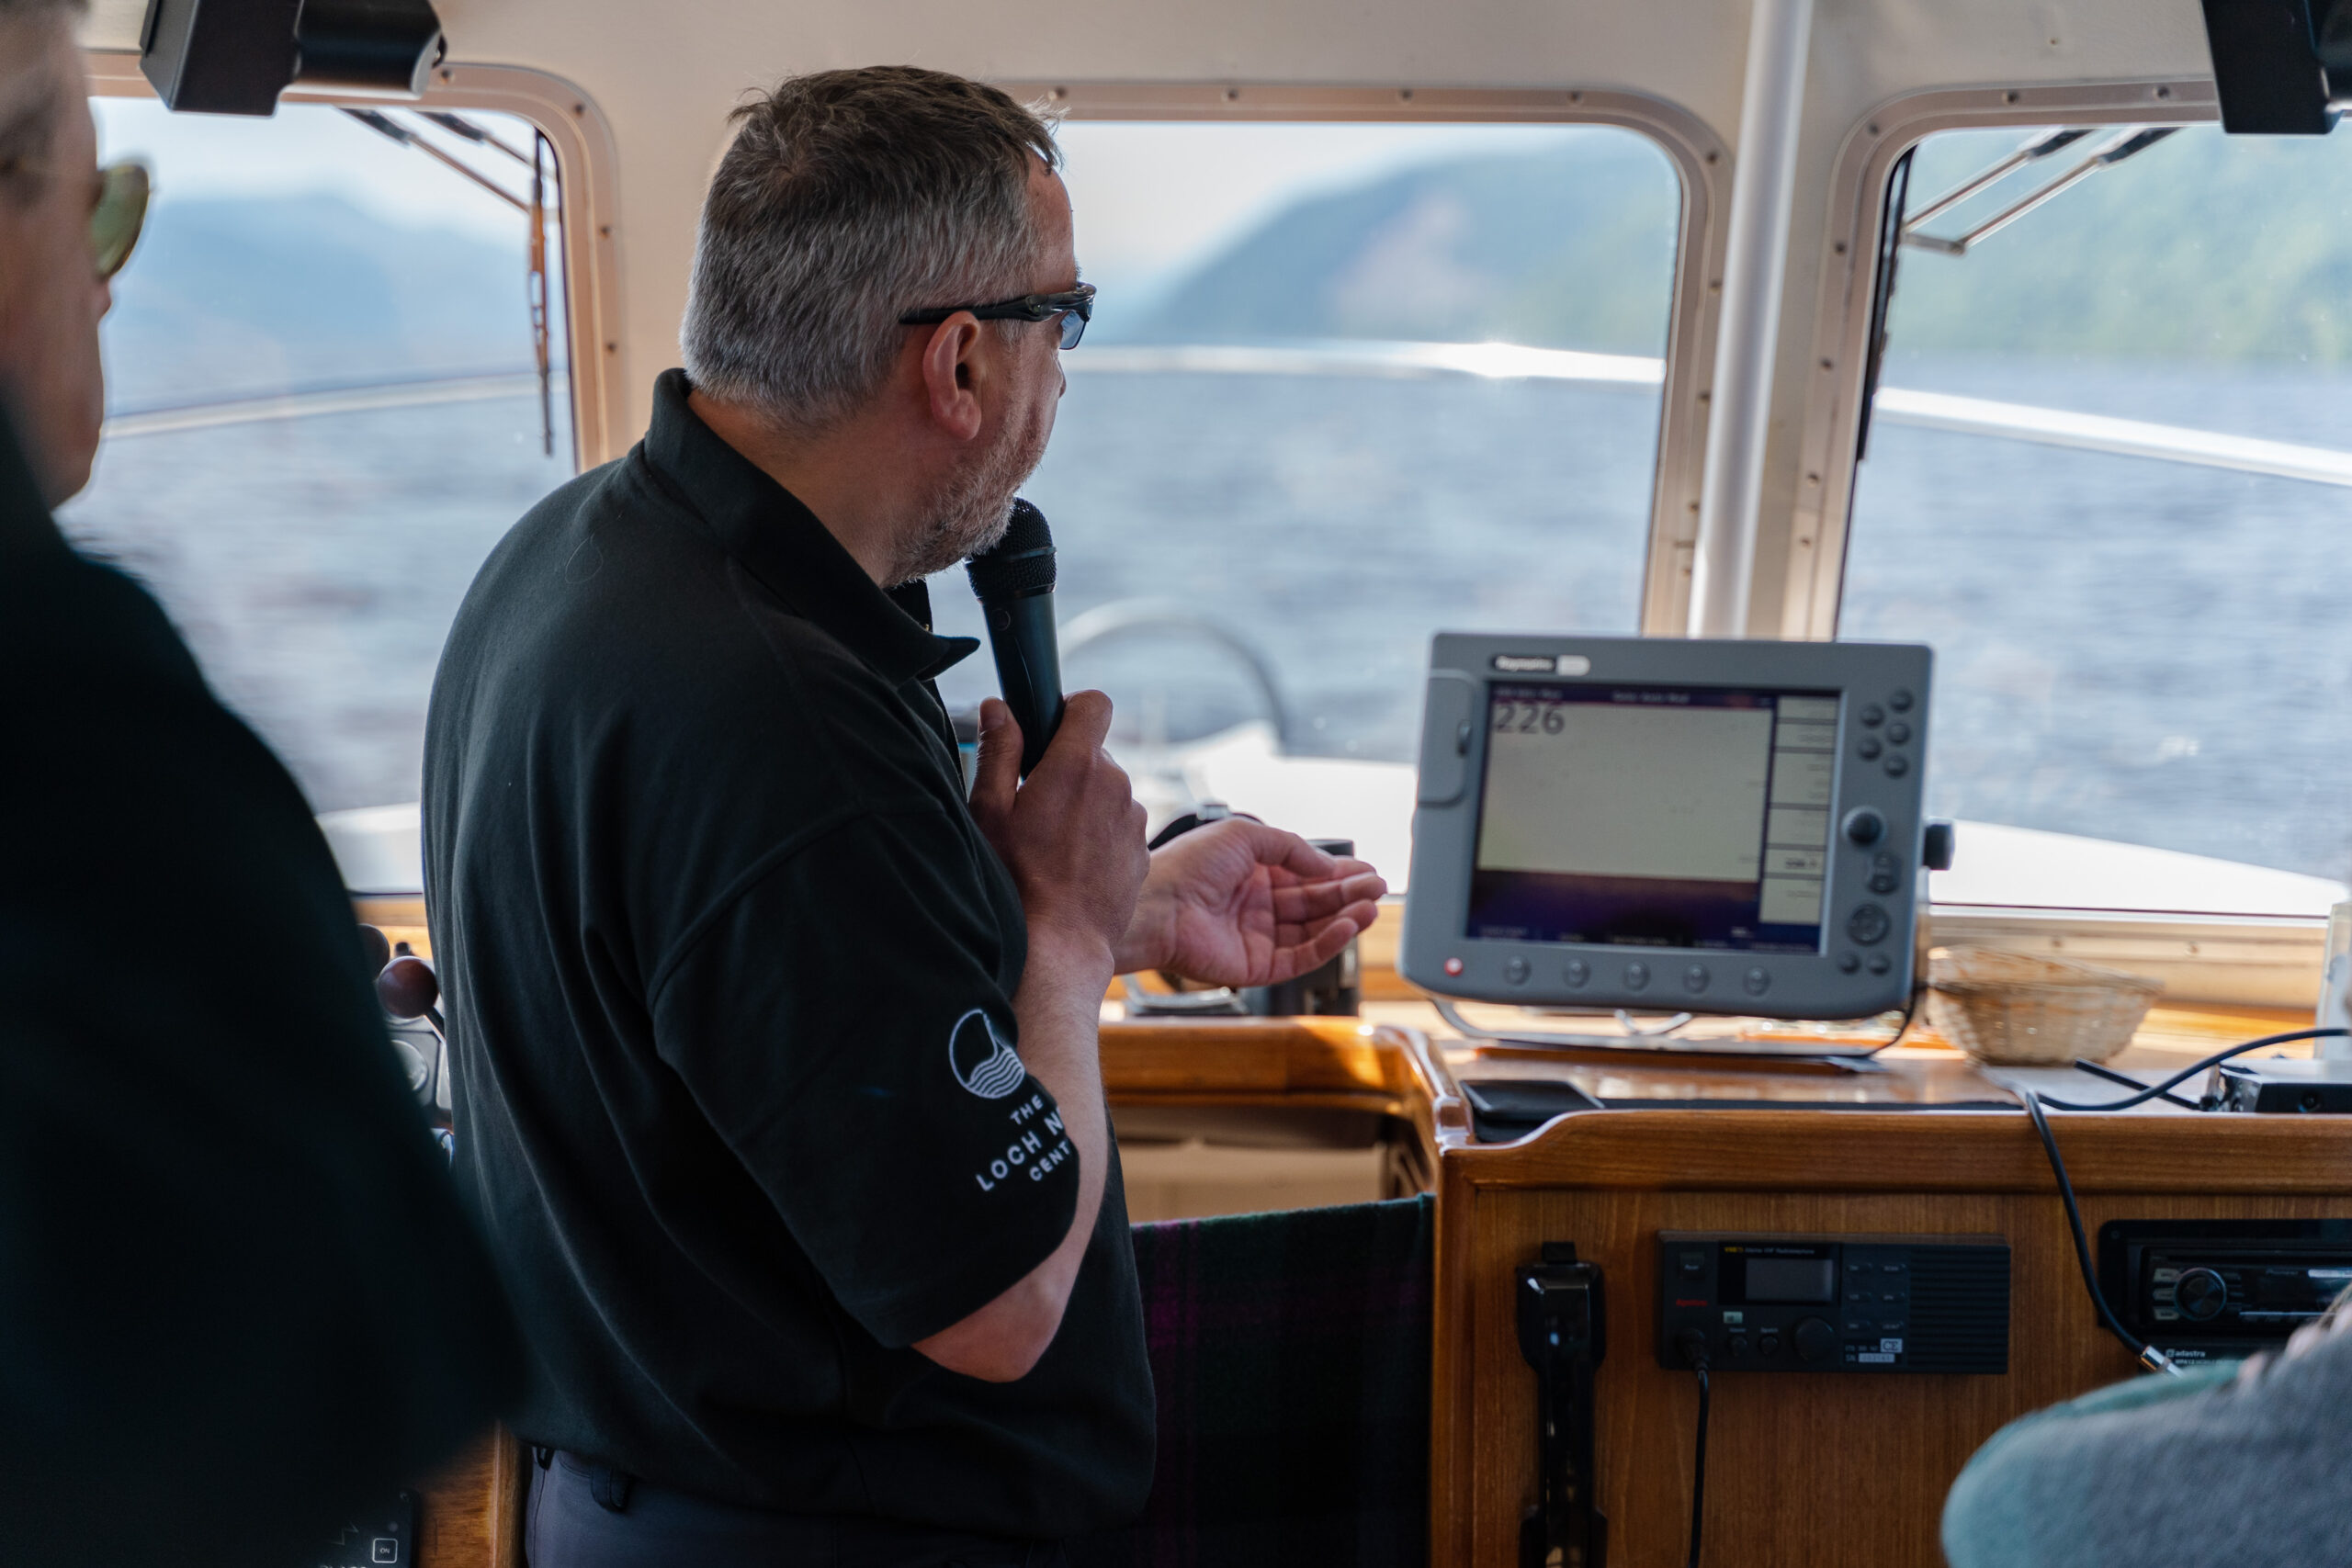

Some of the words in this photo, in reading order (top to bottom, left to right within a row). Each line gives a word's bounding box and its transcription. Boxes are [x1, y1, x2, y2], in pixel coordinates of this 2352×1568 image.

[1496, 702, 1565, 735] 226
[1010, 1095, 1044, 1125] THE
[976, 1131, 1042, 1191] LOCH
